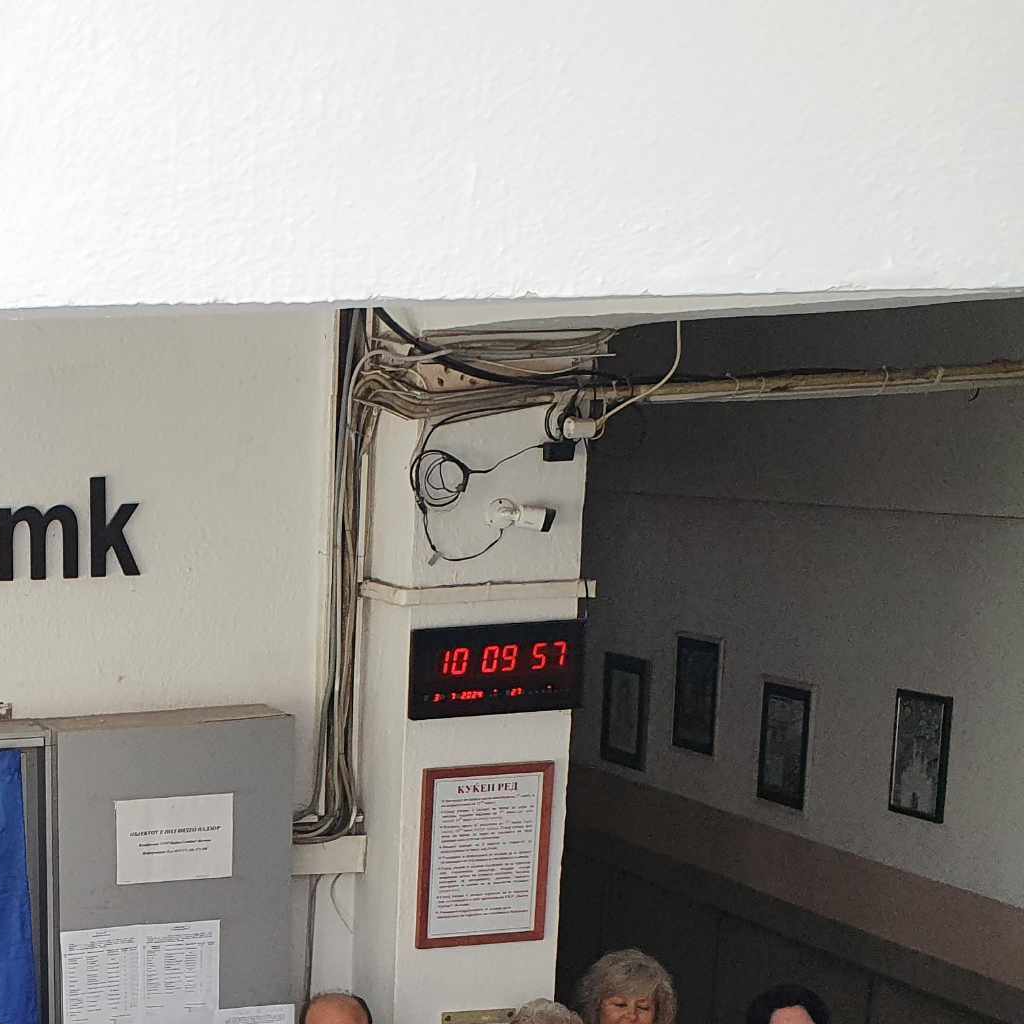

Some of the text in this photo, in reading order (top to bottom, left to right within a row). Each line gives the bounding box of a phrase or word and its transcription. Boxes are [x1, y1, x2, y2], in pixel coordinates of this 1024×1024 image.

[442, 640, 568, 676] 10 09 57
